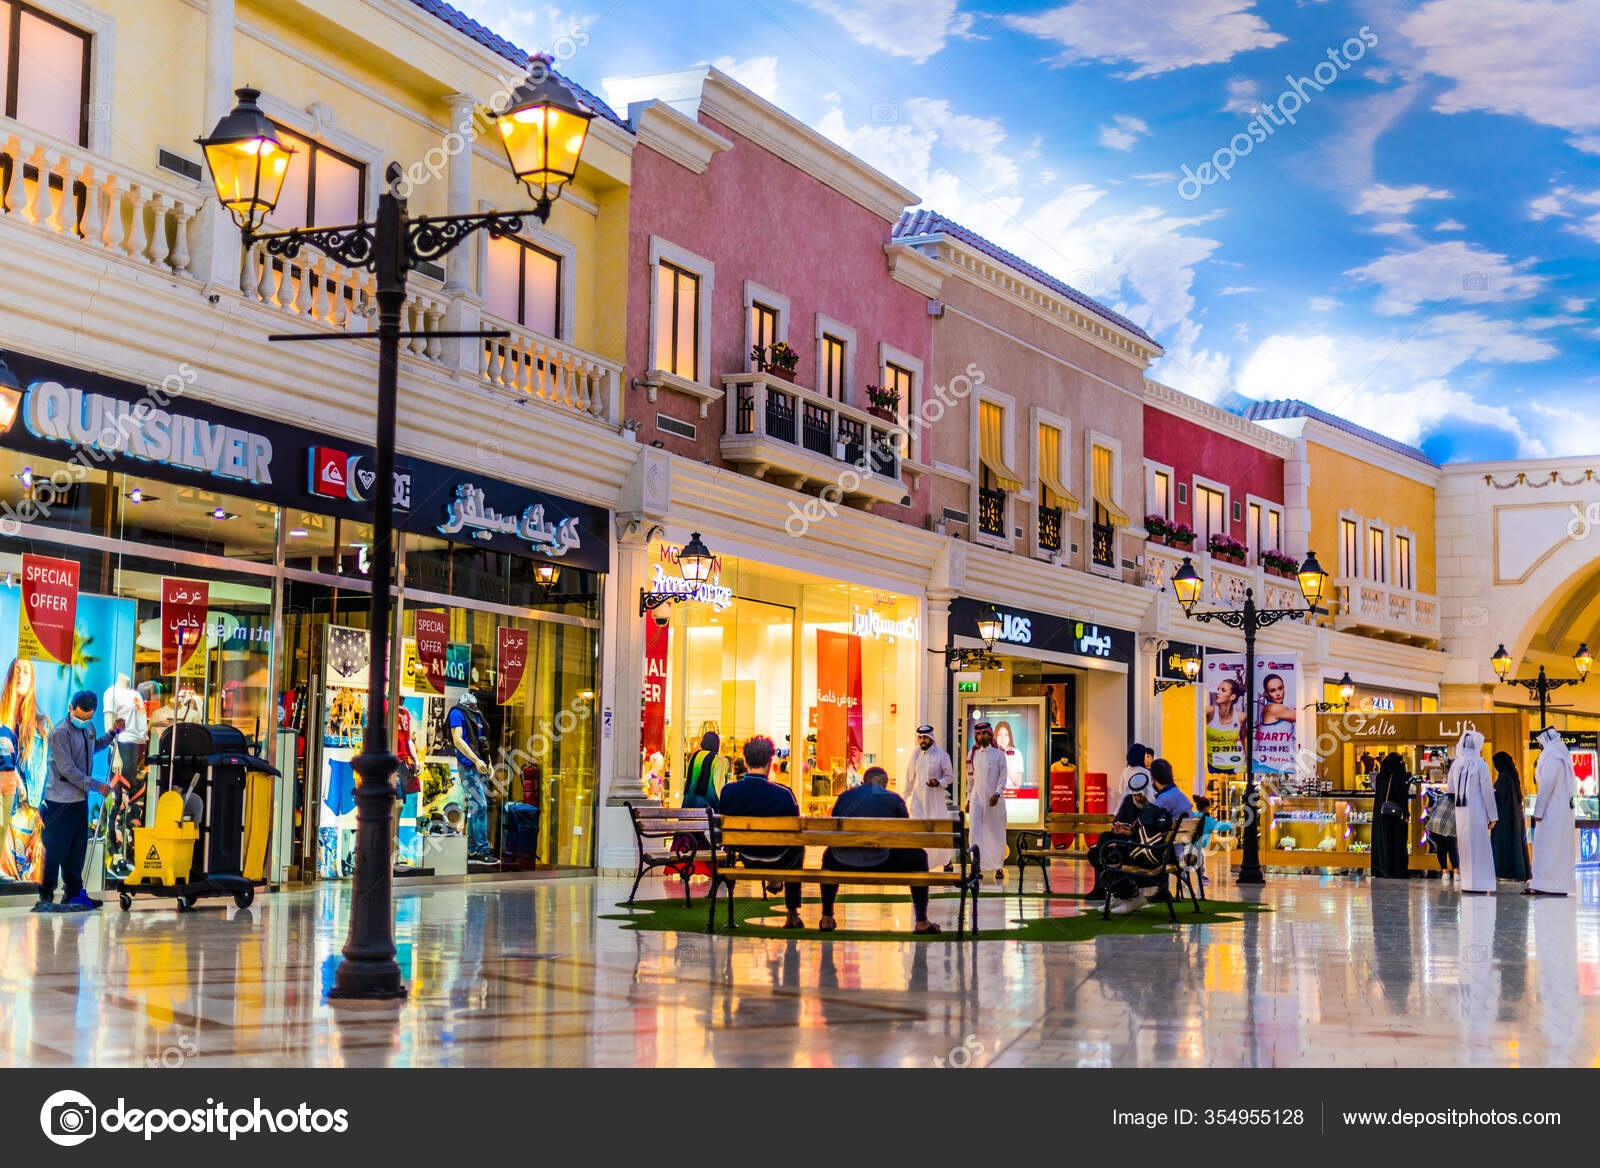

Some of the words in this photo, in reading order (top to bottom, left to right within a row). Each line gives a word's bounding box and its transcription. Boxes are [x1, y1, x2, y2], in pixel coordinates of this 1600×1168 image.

[24, 380, 273, 485] QUIKSILVER
[27, 566, 74, 587] SPECIAL
[30, 593, 68, 611] OFFER
[169, 587, 202, 604] عرض
[170, 612, 199, 630] خاص
[418, 618, 446, 634] SPECIAL
[996, 611, 1032, 643] ules
[420, 639, 442, 653] OFFER
[503, 634, 524, 648] عرض
[503, 655, 522, 669] خاص
[645, 657, 667, 677] IAL
[645, 683, 662, 702] ER
[1529, 690, 1552, 703] ZAA
[1372, 696, 1394, 710] ZARA
[1355, 718, 1397, 738] Zalia
[1256, 732, 1293, 742] BARTY
